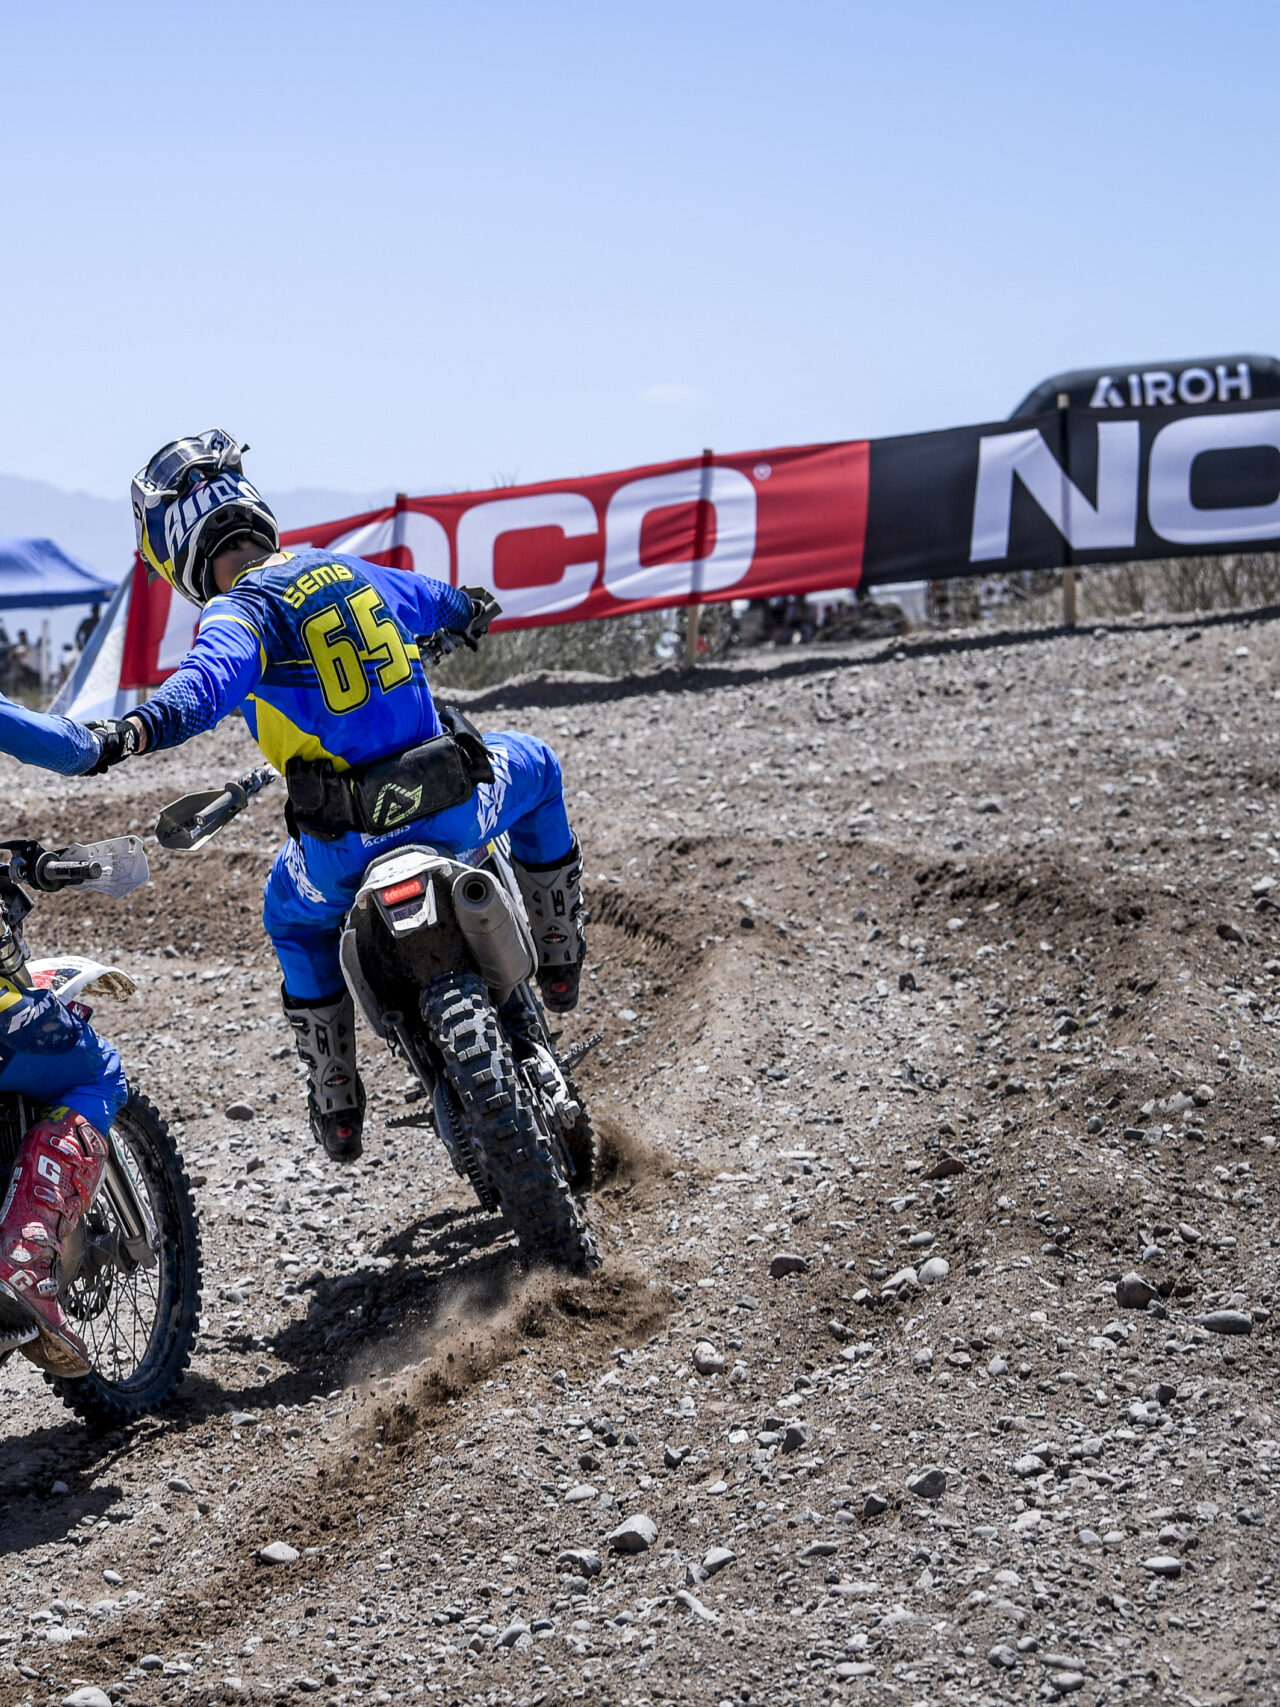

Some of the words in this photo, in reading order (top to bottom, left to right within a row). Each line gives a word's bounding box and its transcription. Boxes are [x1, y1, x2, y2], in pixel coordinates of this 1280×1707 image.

[1089, 362, 1252, 408] AIROH
[282, 563, 355, 609] SEMB
[300, 584, 413, 716] 65
